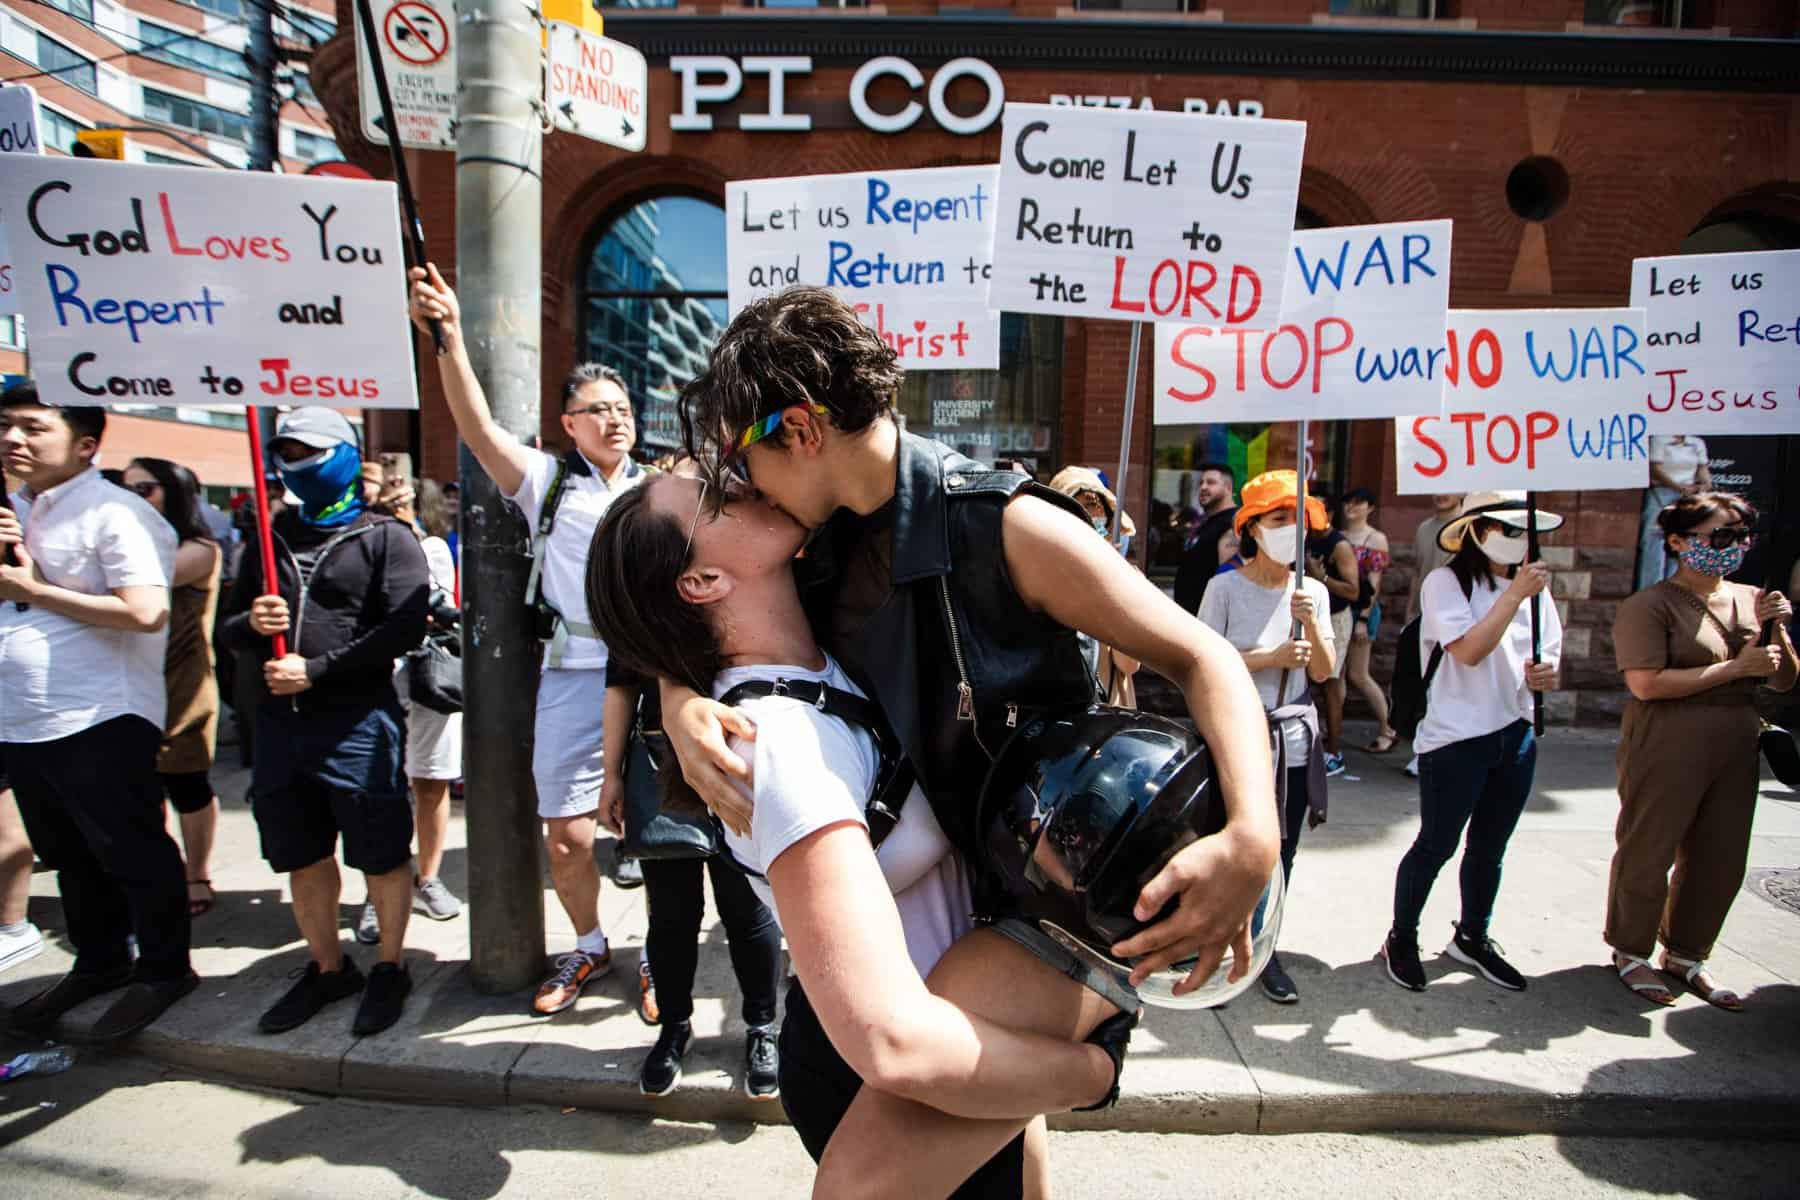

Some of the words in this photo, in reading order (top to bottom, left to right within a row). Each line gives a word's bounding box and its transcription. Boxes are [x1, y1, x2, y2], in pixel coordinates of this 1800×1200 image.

[582, 42, 614, 76] NO
[553, 64, 640, 116] STANDING
[670, 56, 813, 131] PI
[849, 56, 1005, 134] CO
[1015, 121, 1105, 181] Come
[1123, 130, 1177, 186] Let
[1210, 141, 1253, 199] Us
[27, 181, 150, 257] God
[159, 192, 292, 264] Loves
[301, 202, 384, 266] You
[743, 191, 801, 232] Let
[818, 205, 849, 229] us
[866, 178, 989, 235] Repent
[1016, 198, 1134, 250] Return
[1182, 222, 1222, 252] to
[749, 255, 801, 287] and
[827, 241, 945, 289] Return
[1030, 273, 1087, 303] the
[1110, 256, 1262, 324] LORD
[1294, 234, 1437, 296] WAR
[1649, 267, 1701, 297] Let
[1731, 272, 1763, 291] us
[45, 263, 225, 343] Repent
[279, 296, 343, 325] and
[1167, 317, 1354, 403] STOP
[1355, 346, 1446, 383] war
[1525, 325, 1646, 383] WAR
[1647, 321, 1701, 347] and
[68, 352, 175, 397] Come
[200, 365, 244, 395] to
[259, 358, 380, 399] Jesus
[1647, 369, 1778, 413] Jesus
[933, 400, 994, 409] UNIVERSITY
[1412, 410, 1560, 478] STOP
[1567, 414, 1647, 462] WAR
